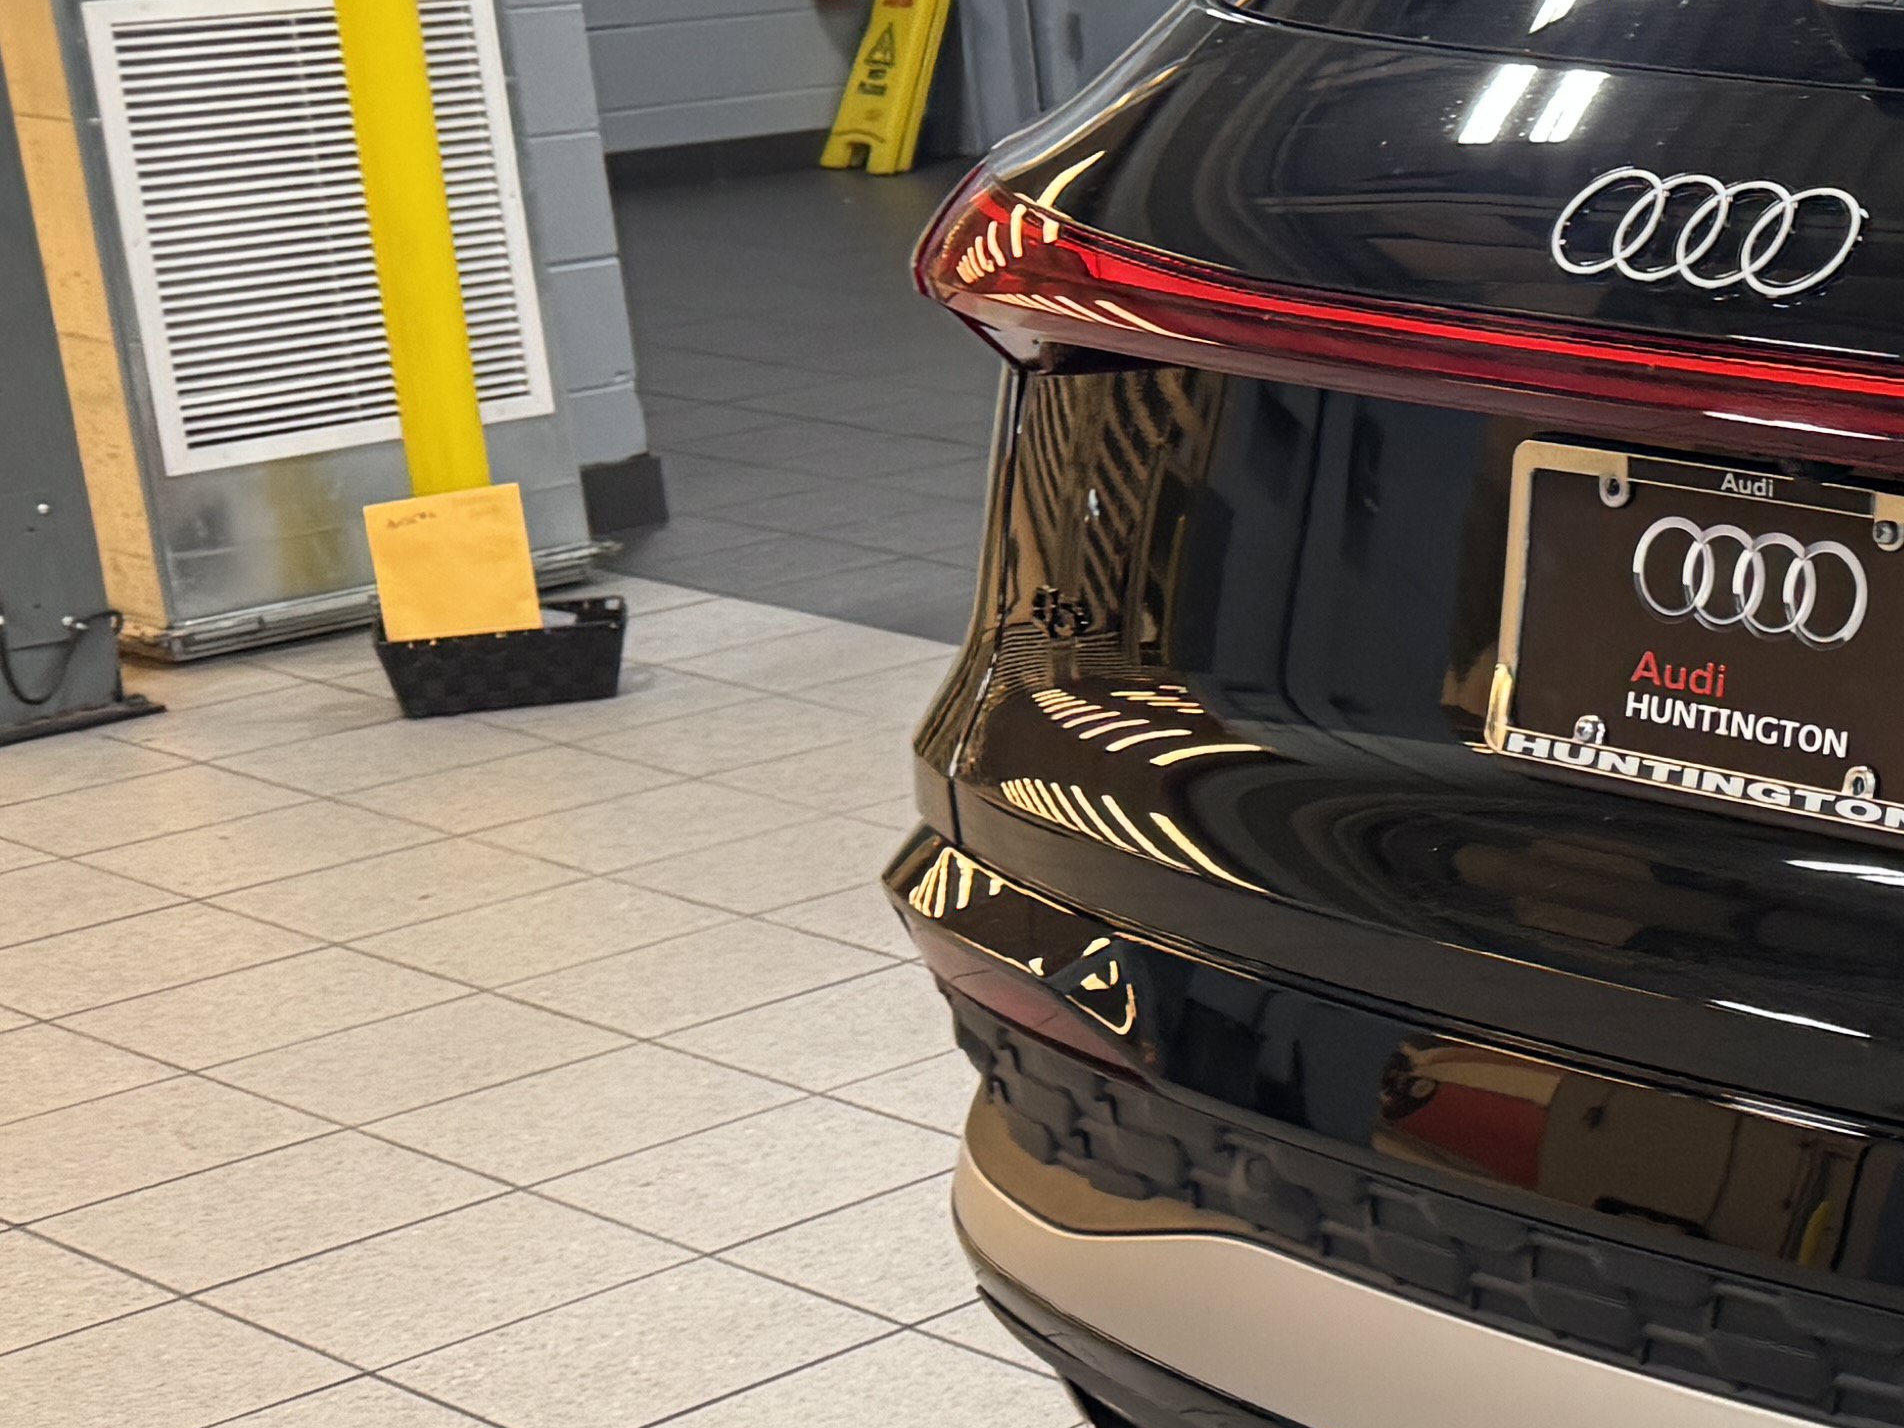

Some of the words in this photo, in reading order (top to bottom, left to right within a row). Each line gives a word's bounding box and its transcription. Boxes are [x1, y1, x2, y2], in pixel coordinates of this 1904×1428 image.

[1720, 472, 1774, 498] Audi
[1630, 650, 1726, 698] Audi
[1625, 690, 1848, 759] HUNTINGTON
